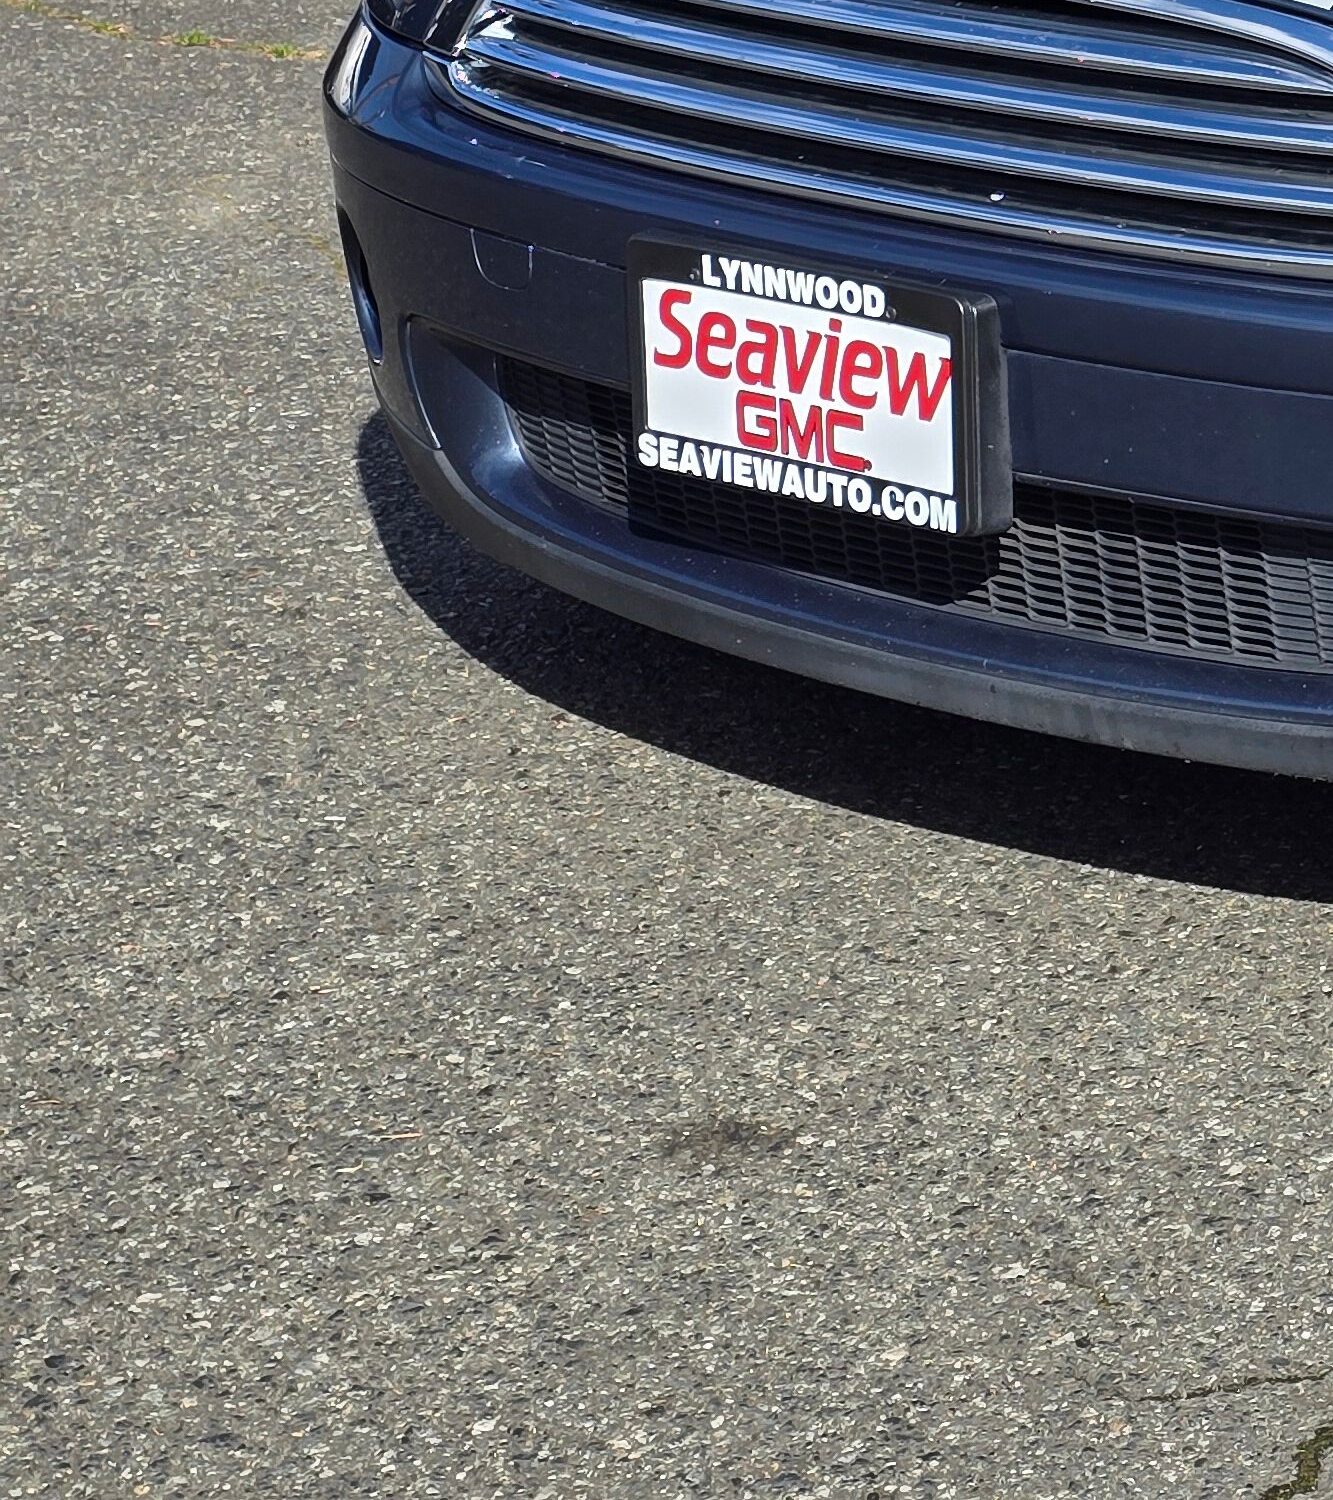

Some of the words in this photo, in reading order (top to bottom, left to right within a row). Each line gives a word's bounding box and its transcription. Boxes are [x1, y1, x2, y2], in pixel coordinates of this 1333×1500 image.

[701, 254, 886, 319] LYNNWOOD
[653, 287, 953, 422] Seaview
[736, 389, 868, 472] GMC
[638, 433, 957, 534] SEAVIEWAUTO.COM
